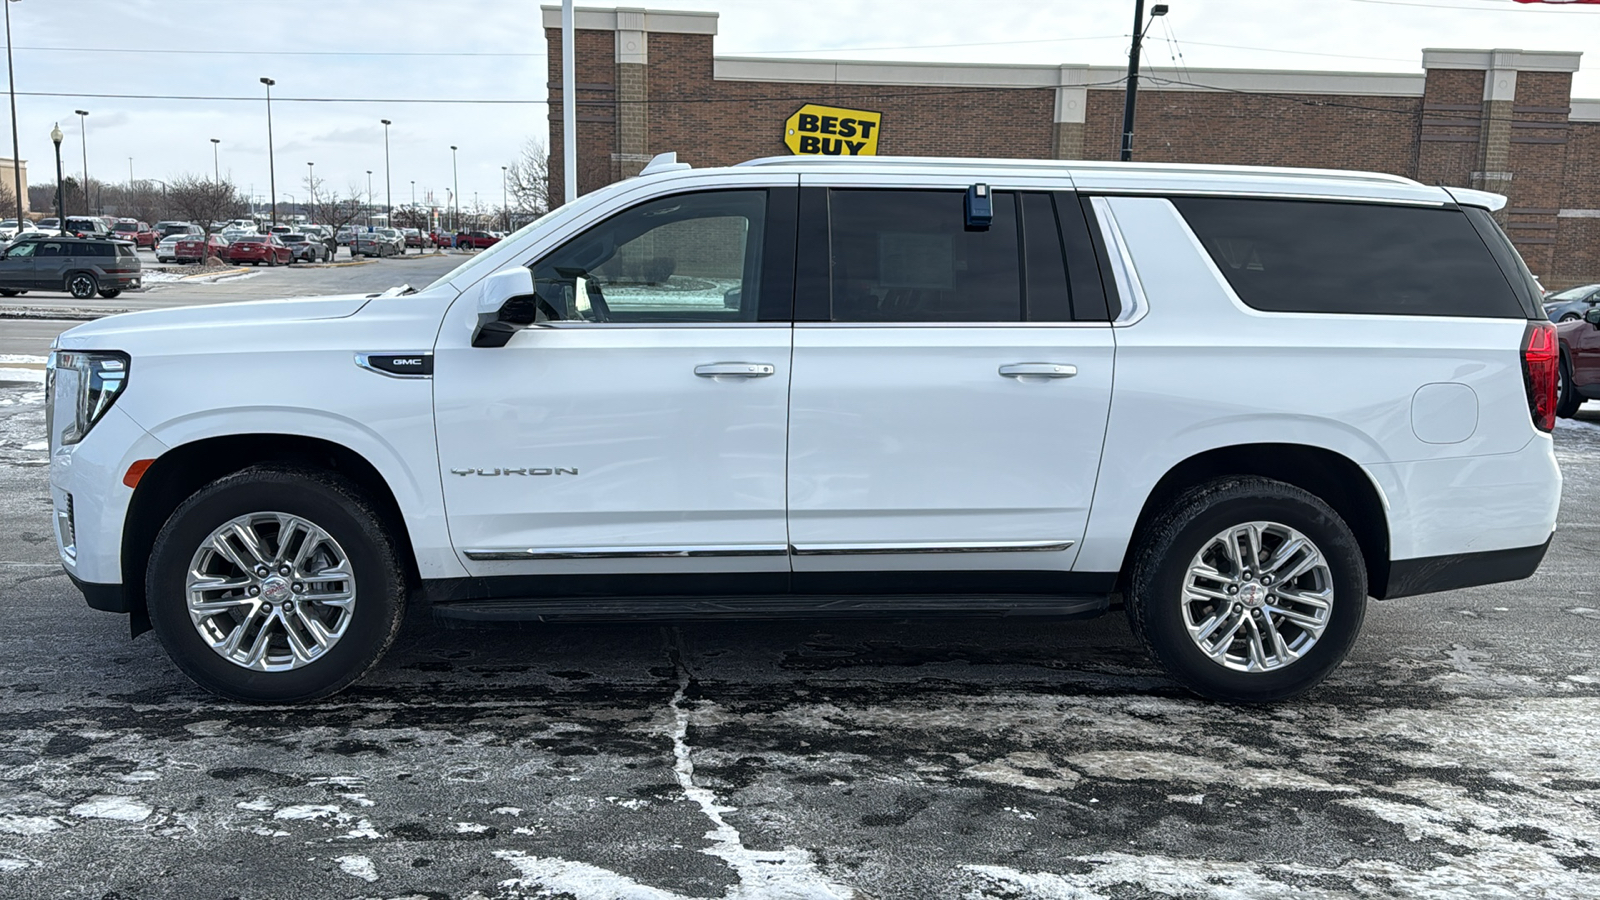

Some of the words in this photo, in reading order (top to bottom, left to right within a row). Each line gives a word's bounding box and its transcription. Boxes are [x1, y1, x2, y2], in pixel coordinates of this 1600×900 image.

[798, 113, 876, 139] BEST
[799, 135, 867, 155] BUY
[450, 466, 578, 477] YUKON
[265, 584, 286, 597] GMC
[1248, 585, 1257, 605] GMC
